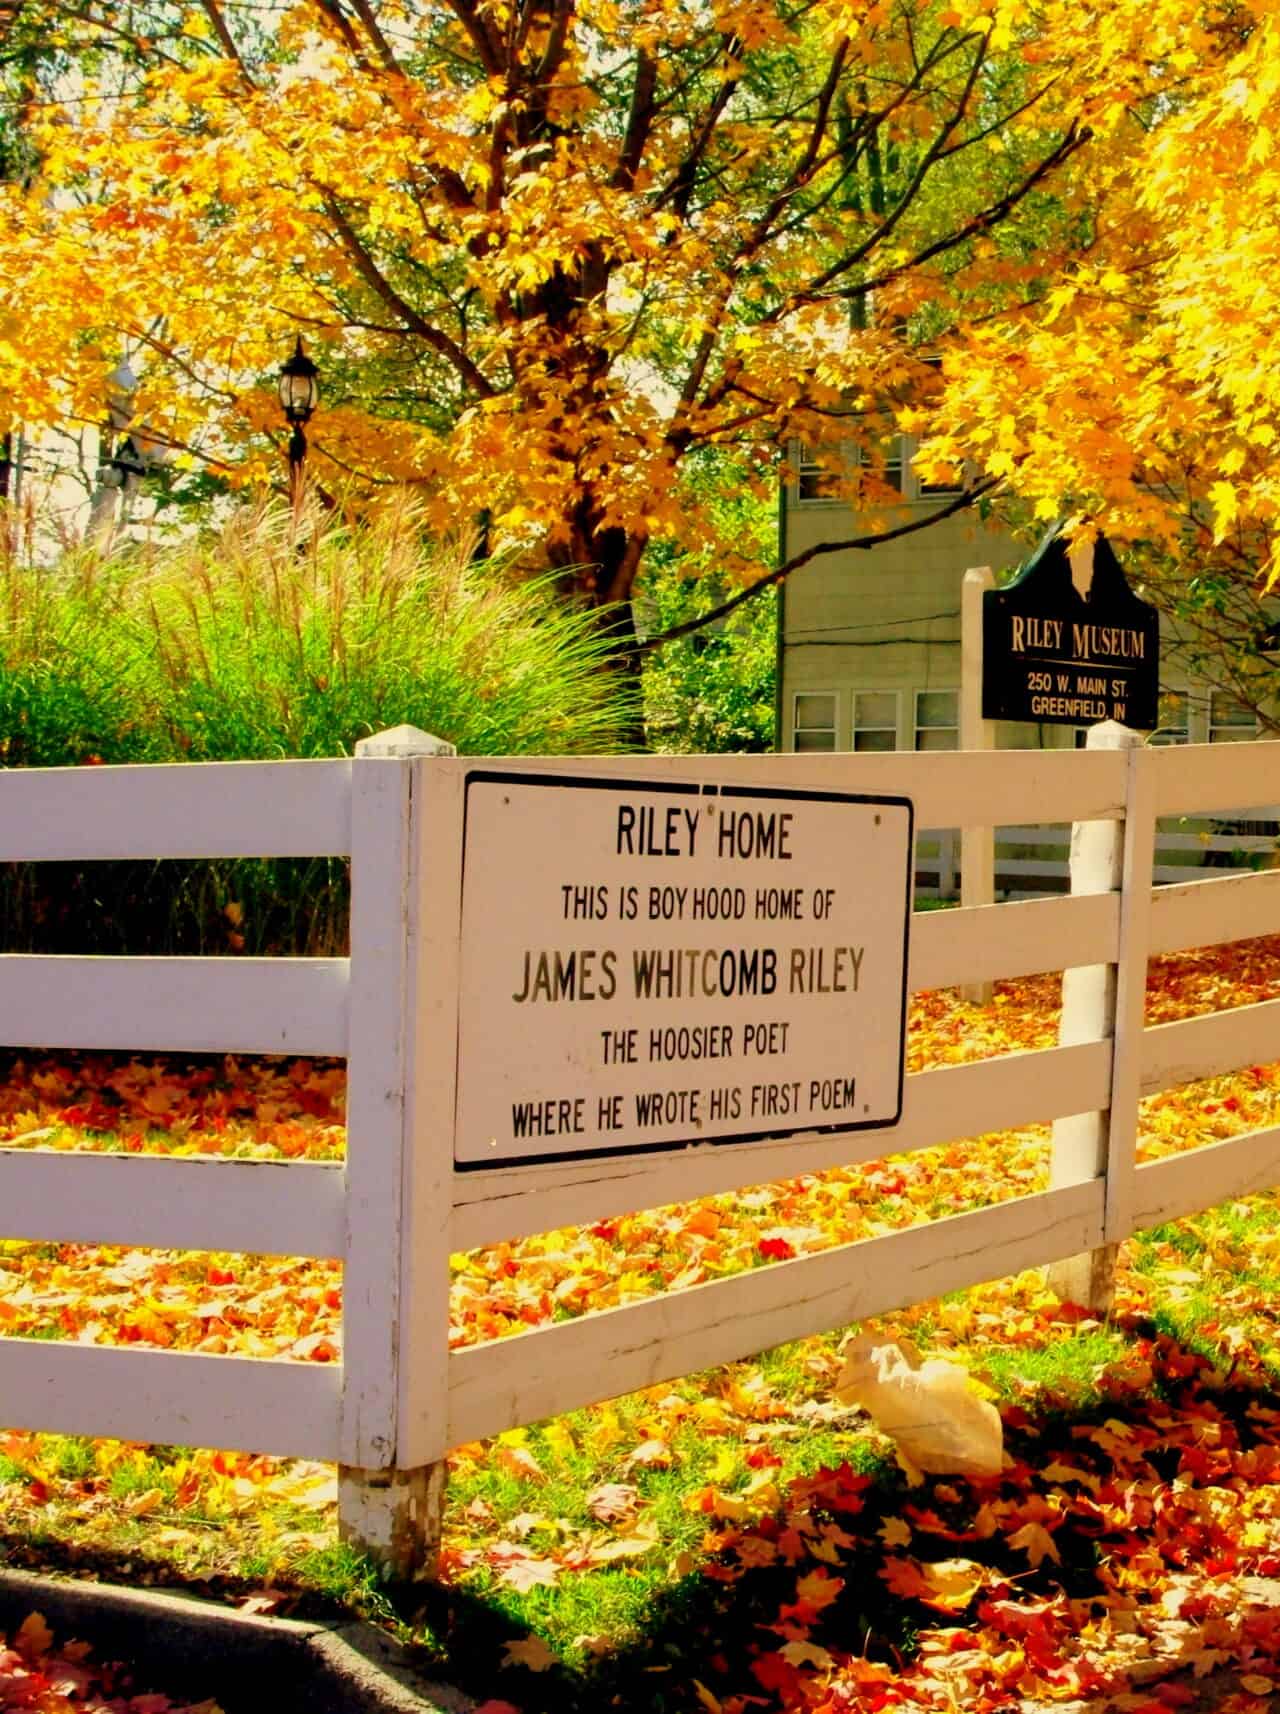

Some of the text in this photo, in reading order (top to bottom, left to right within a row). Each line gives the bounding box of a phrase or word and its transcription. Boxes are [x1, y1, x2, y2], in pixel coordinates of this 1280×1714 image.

[1011, 615, 1145, 659] RILEY MUSEUM
[1028, 672, 1129, 698] 250 W. MAIN ST.
[1113, 702, 1126, 721] IN
[617, 805, 793, 859] RILEY HOME
[561, 885, 608, 920] THIS
[619, 886, 638, 920] IS
[755, 888, 803, 920] HOME
[813, 889, 836, 920] OF
[512, 946, 865, 1003] JAMES WHITCOMB RILEY
[601, 1022, 790, 1065] THE HOOSIER POET
[512, 1077, 856, 1138] WHERE HE WROTE HIS FIRST POEM
